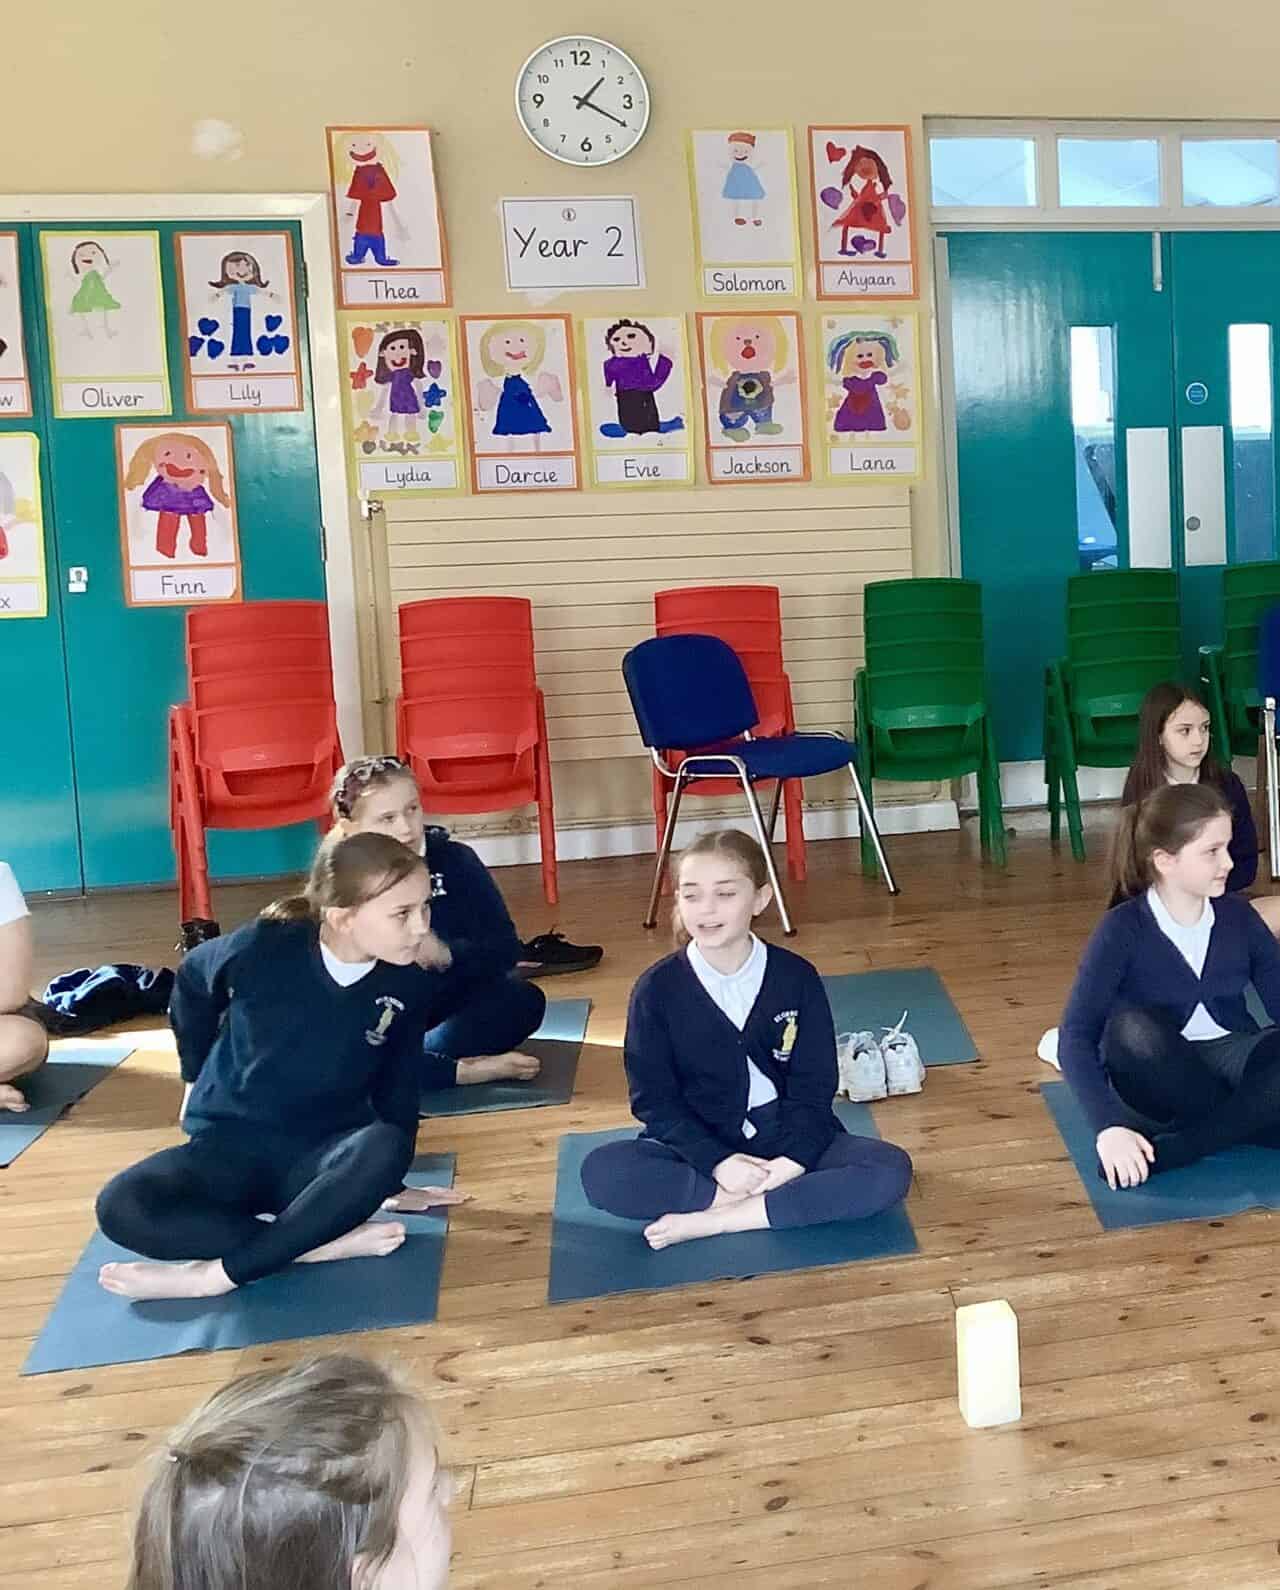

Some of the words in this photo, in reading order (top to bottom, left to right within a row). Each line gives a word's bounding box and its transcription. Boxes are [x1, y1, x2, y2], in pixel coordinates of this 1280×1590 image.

[553, 59, 564, 68] 11
[570, 50, 591, 66] 12
[537, 74, 549, 84] 10
[617, 75, 625, 85] 2
[532, 93, 545, 109] 9
[622, 94, 633, 109] 3
[560, 134, 567, 143] 7
[580, 137, 592, 152] 6
[605, 135, 612, 143] 5
[513, 227, 588, 258] Year
[605, 226, 624, 256] 2
[367, 280, 419, 299] Thea
[713, 273, 786, 291] Solomon
[838, 271, 895, 291] Ahyaan
[82, 388, 144, 407] Oliver
[229, 383, 262, 407] Lily
[623, 459, 661, 478] Evie
[722, 456, 791, 475] Jackson
[851, 453, 896, 470] Lana
[385, 467, 431, 487] Lydia
[496, 465, 557, 484] Darcie
[162, 575, 206, 594] Finn
